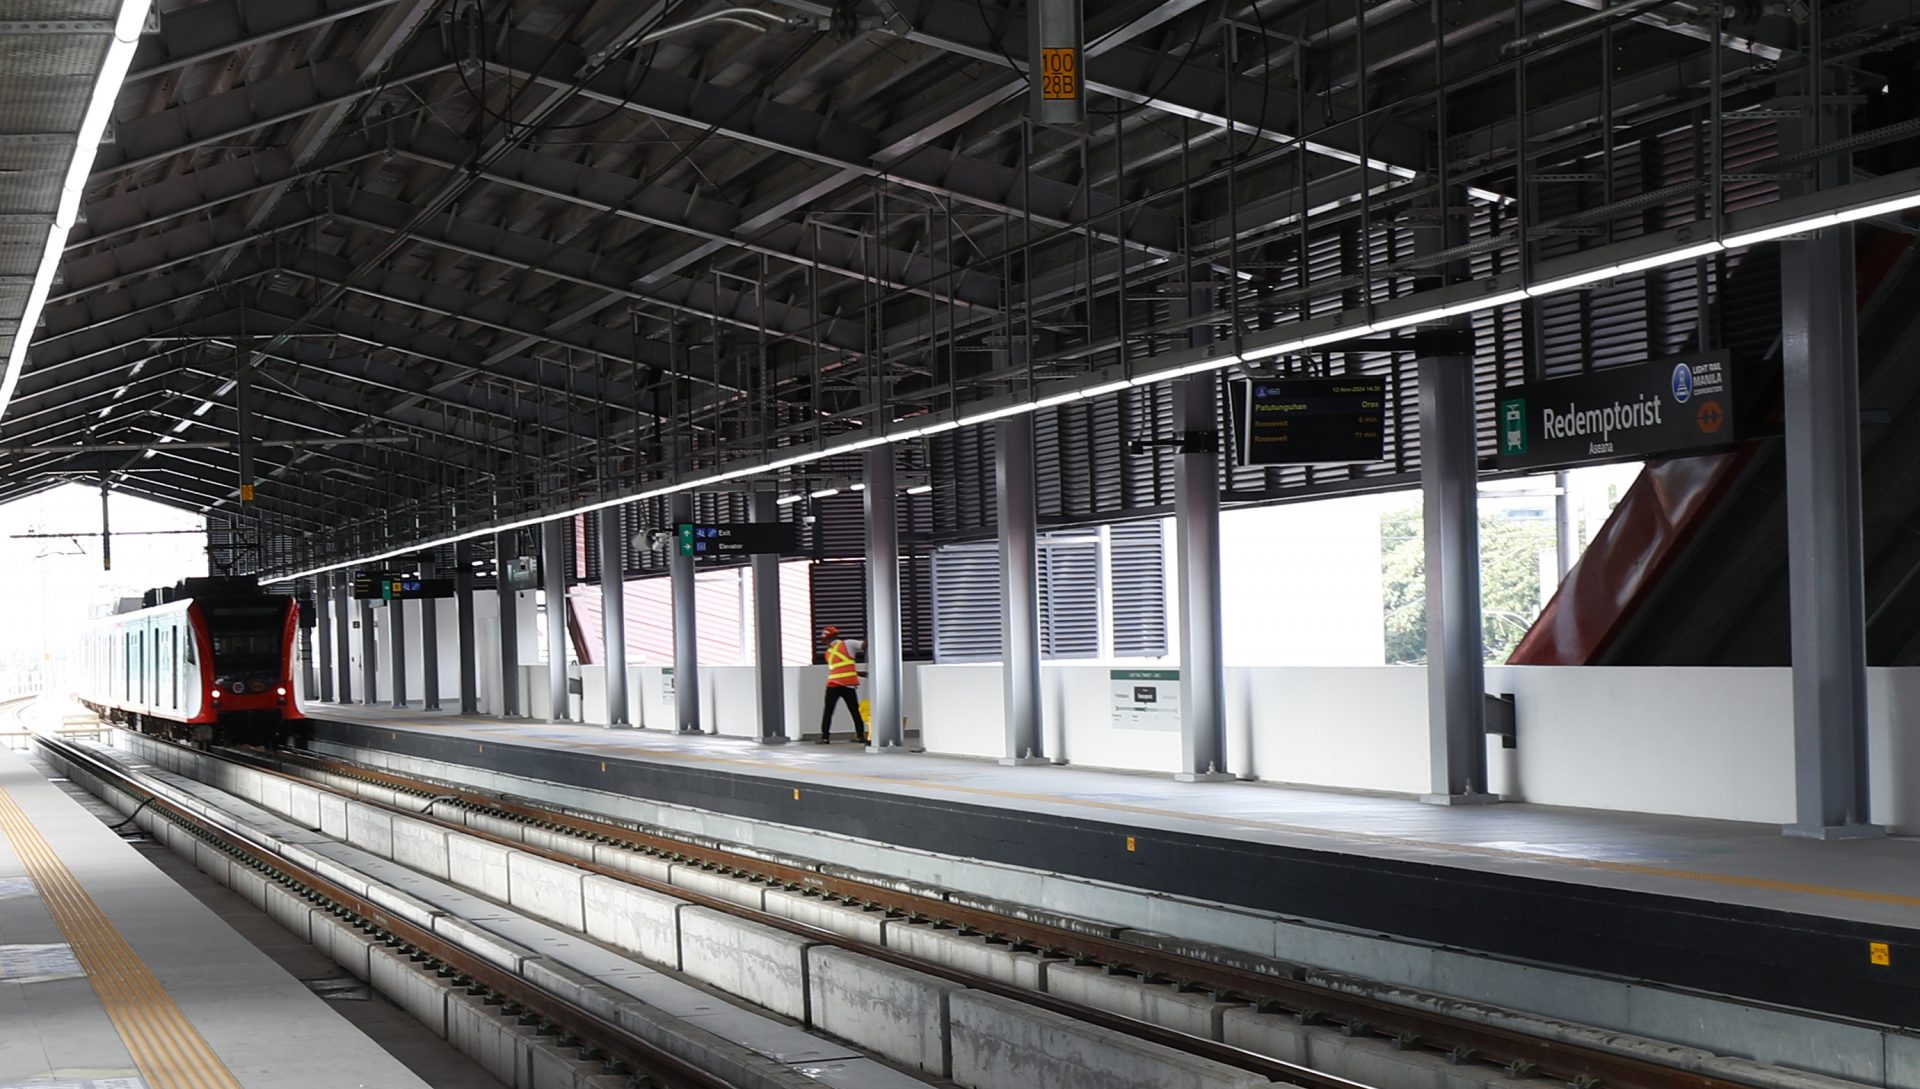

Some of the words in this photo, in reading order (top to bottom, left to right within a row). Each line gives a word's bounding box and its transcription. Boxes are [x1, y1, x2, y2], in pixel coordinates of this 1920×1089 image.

[1043, 53, 1073, 72] 100
[1043, 75, 1074, 94] 28B
[1692, 364, 1708, 375] LIGHT
[1708, 362, 1723, 371] RAIL
[1692, 372, 1723, 387] MANILA
[1543, 394, 1662, 442] Redemptorist
[1588, 441, 1614, 456] Aseana
[718, 529, 731, 537] Exit
